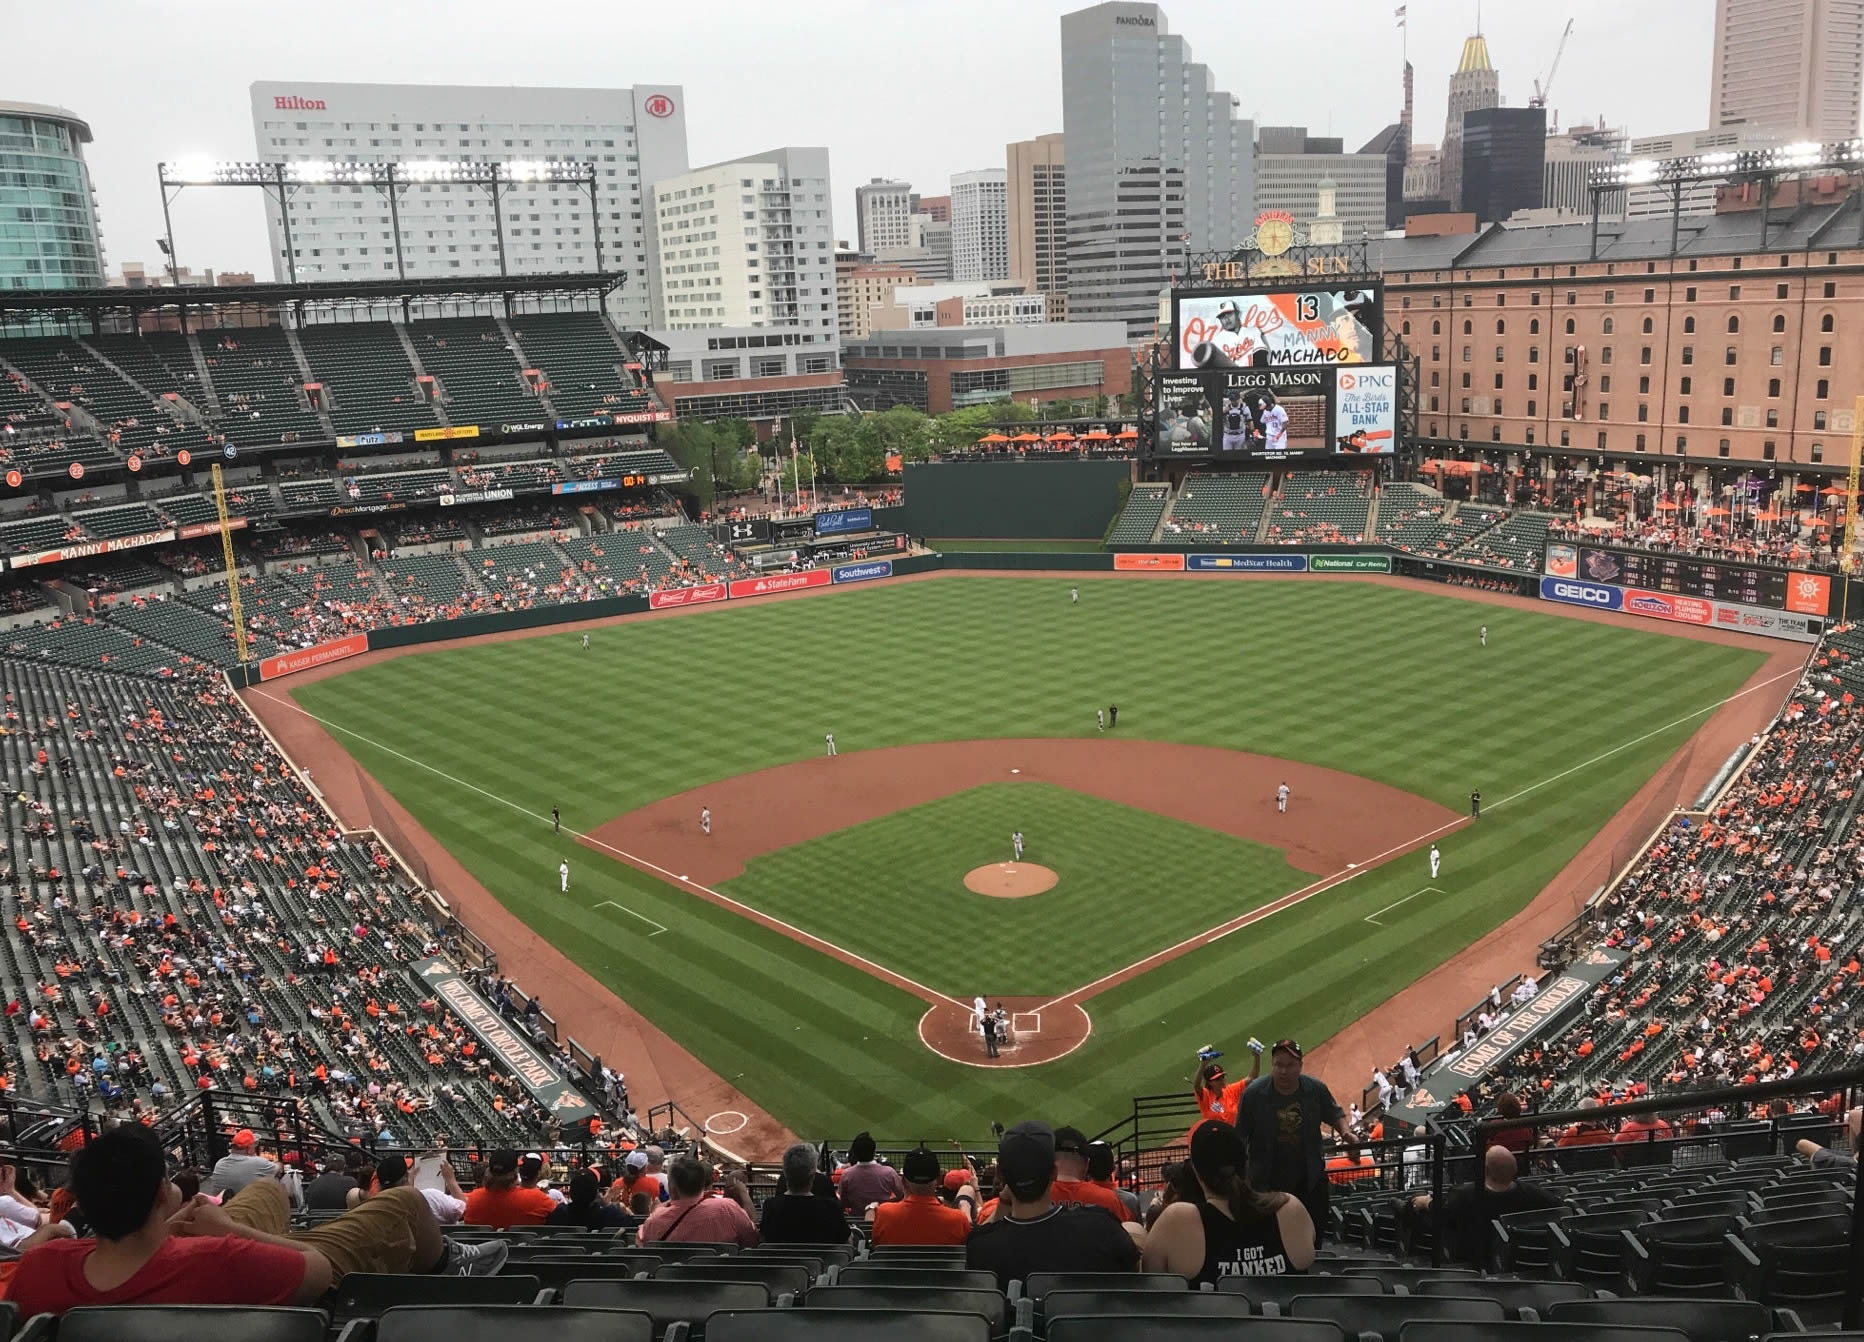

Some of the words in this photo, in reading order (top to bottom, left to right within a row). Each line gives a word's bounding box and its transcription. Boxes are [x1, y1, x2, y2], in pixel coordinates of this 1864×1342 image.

[273, 95, 327, 110] Hilton
[1202, 261, 1244, 280] THE
[1307, 256, 1350, 275] SUN
[1296, 295, 1320, 321] 13
[1183, 304, 1284, 354] Orles
[1284, 325, 1341, 348] MANNY
[1269, 348, 1349, 364] MACHADO
[1162, 377, 1198, 385] Investing
[1228, 373, 1266, 387] LEGG
[1270, 372, 1322, 385] MASON
[1359, 375, 1392, 388] PNC
[1173, 386, 1204, 394] Improve
[1342, 402, 1389, 414] ALL-STAR
[1352, 414, 1378, 425] BANK
[524, 423, 544, 431] Energy
[225, 446, 236, 457] 42
[72, 466, 83, 475] 22
[130, 460, 139, 469] 33
[11, 476, 17, 484] 4
[484, 488, 513, 500] UNION
[60, 543, 102, 560] MANNY
[107, 533, 161, 553] MACHADO
[1233, 559, 1264, 567] MedStar
[1266, 559, 1292, 567] Health
[1323, 559, 1353, 567] National
[839, 568, 881, 579] Southwest
[1554, 583, 1610, 603] GEICO
[1630, 600, 1672, 614] HORIZON
[1675, 599, 1702, 608] HEATING
[1675, 605, 1708, 616] PLUMBING
[1675, 611, 1703, 621] COOLING
[288, 658, 311, 669] KAISER
[1454, 1043, 1502, 1076] HOME
[1491, 1030, 1517, 1046] OF
[1505, 1011, 1543, 1033] THE
[1530, 978, 1583, 1014] ORIOLES
[441, 980, 487, 1020] WELCOME
[475, 1016, 499, 1031] TO
[488, 1030, 530, 1065] ORIOLE
[516, 1059, 554, 1087] PARK
[1236, 1248, 1241, 1261] I
[1243, 1245, 1264, 1260] GOT
[1218, 1254, 1286, 1276] TANKED
